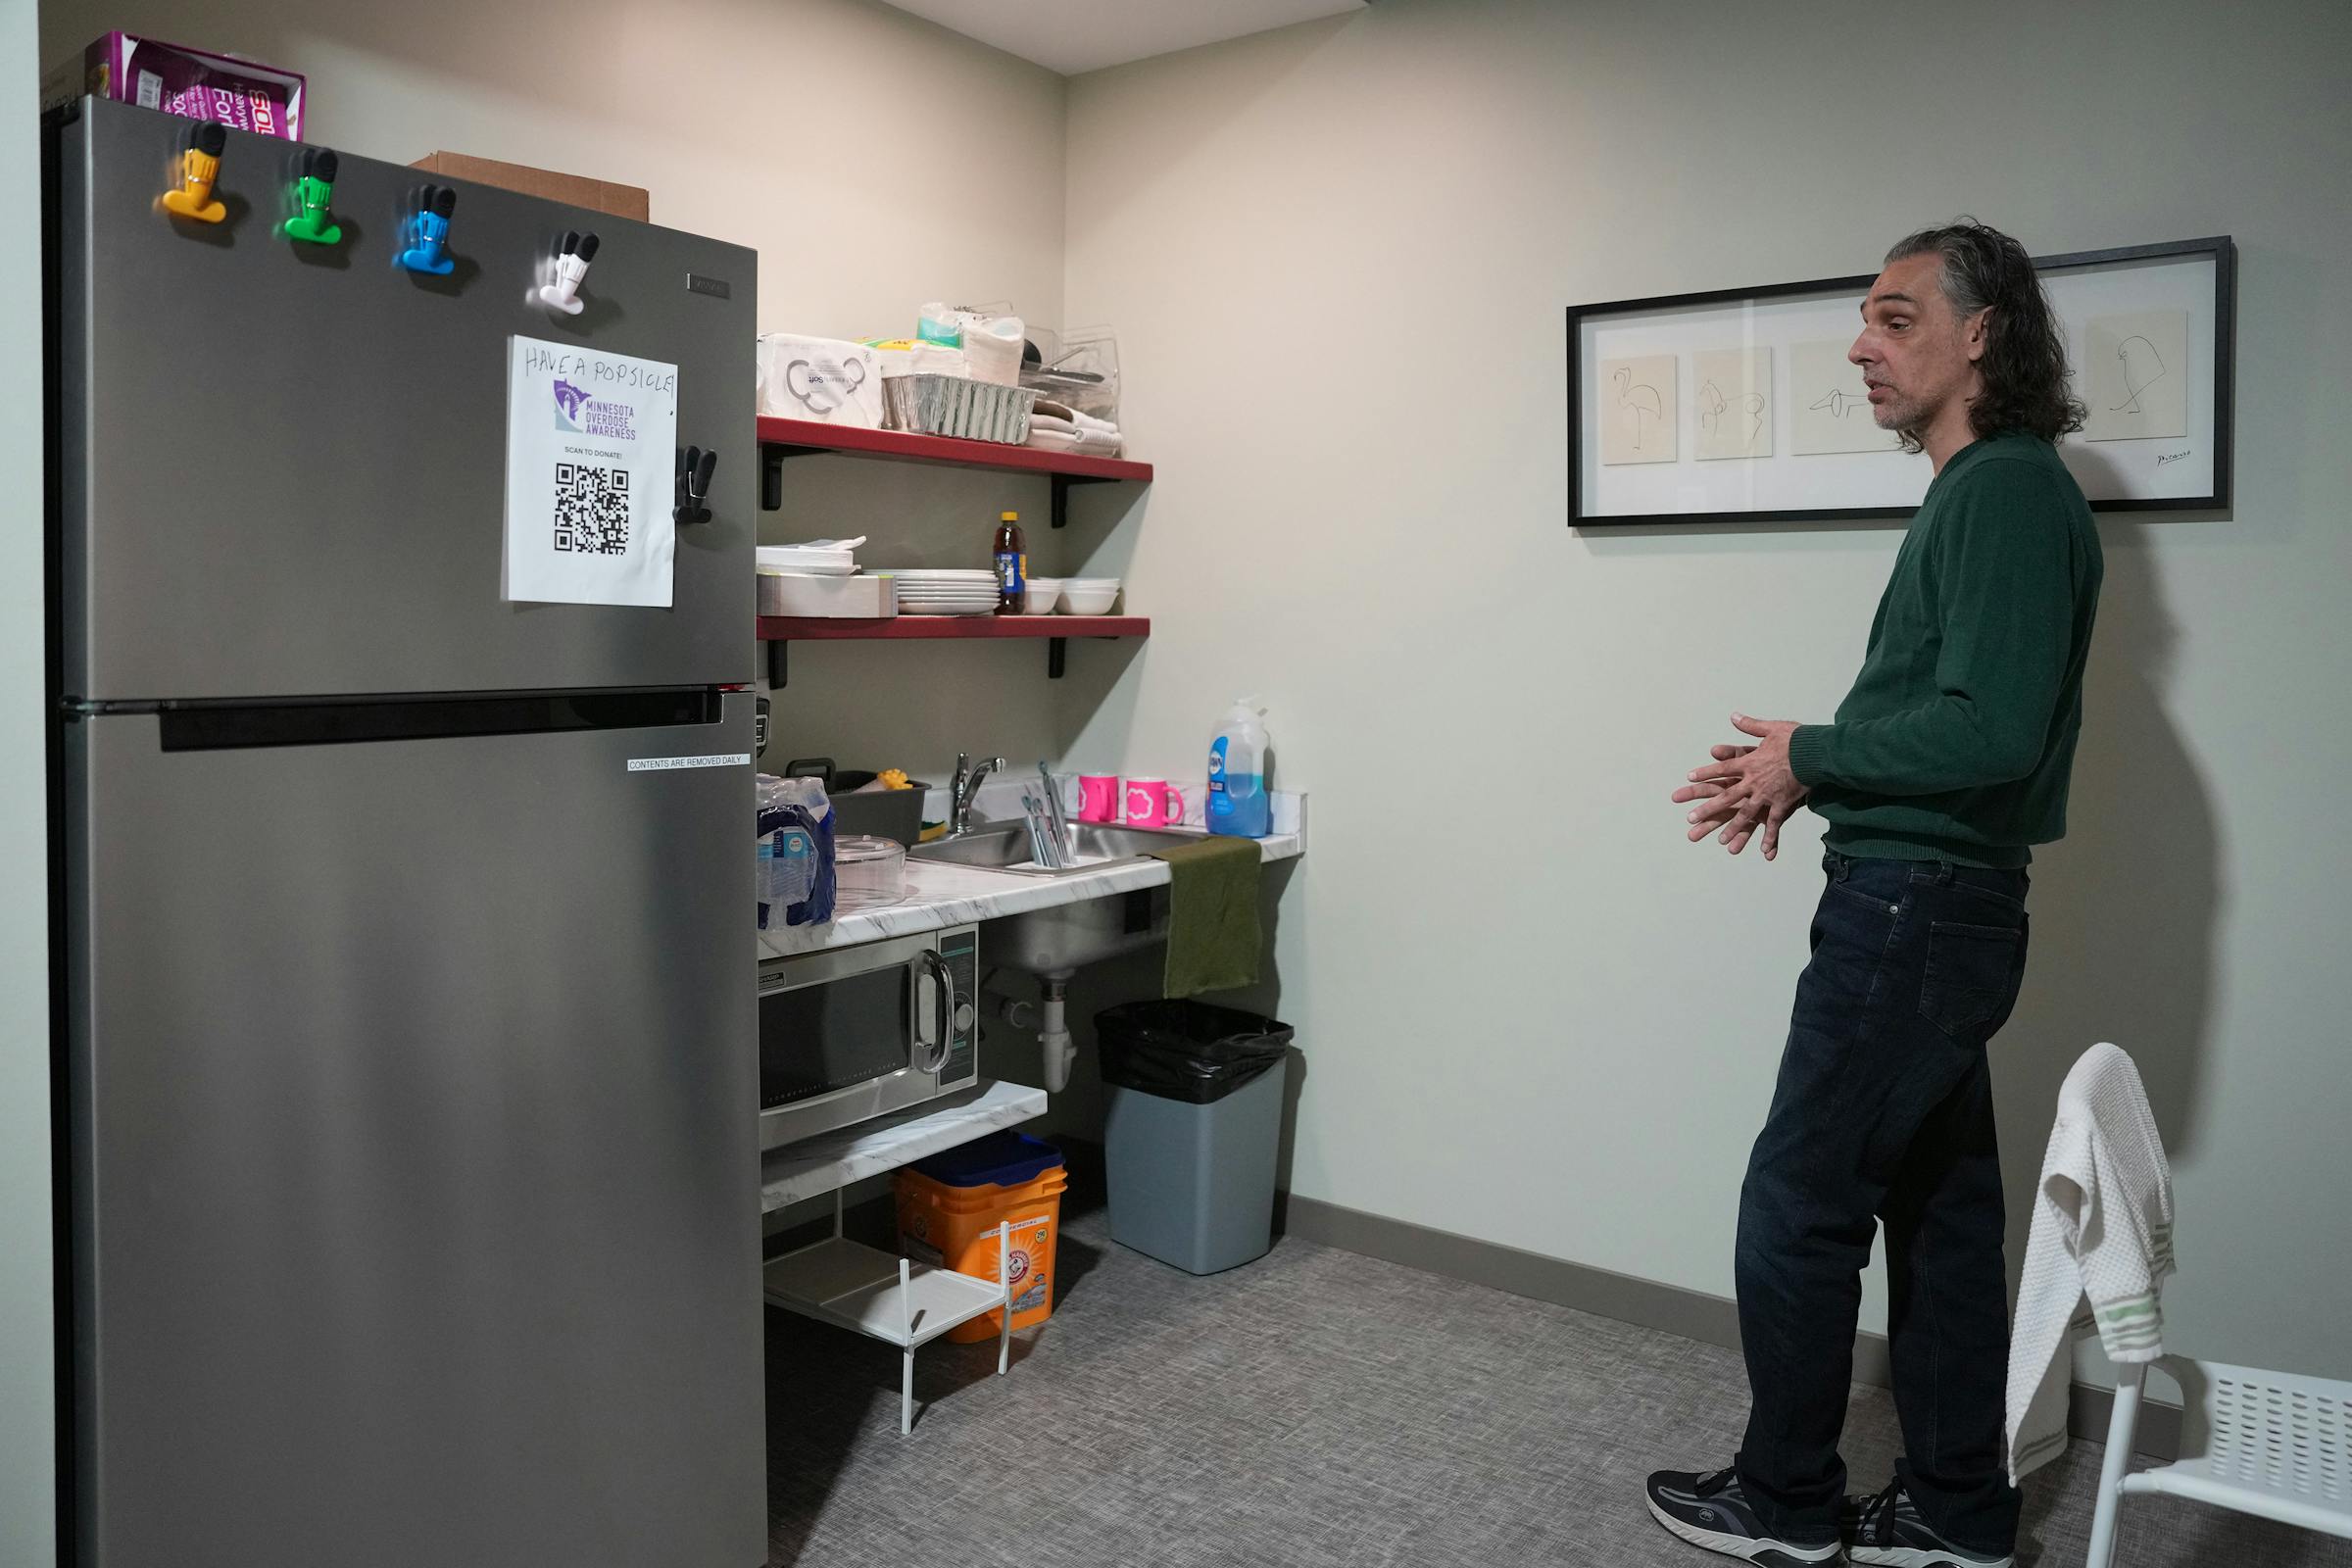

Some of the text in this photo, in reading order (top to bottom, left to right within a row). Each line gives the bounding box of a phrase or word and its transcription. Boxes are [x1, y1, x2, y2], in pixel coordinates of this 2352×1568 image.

[249, 89, 275, 135] SOL
[525, 346, 571, 377] HAVE
[574, 357, 586, 376] A
[586, 400, 635, 418] MINNESOTA
[586, 412, 629, 429] OVERDOSE
[586, 423, 636, 441] AWARENESS
[564, 446, 583, 455] SCAN
[585, 448, 593, 457] TO
[629, 756, 742, 770] CONTENTS ARE REMOVED DAILY
